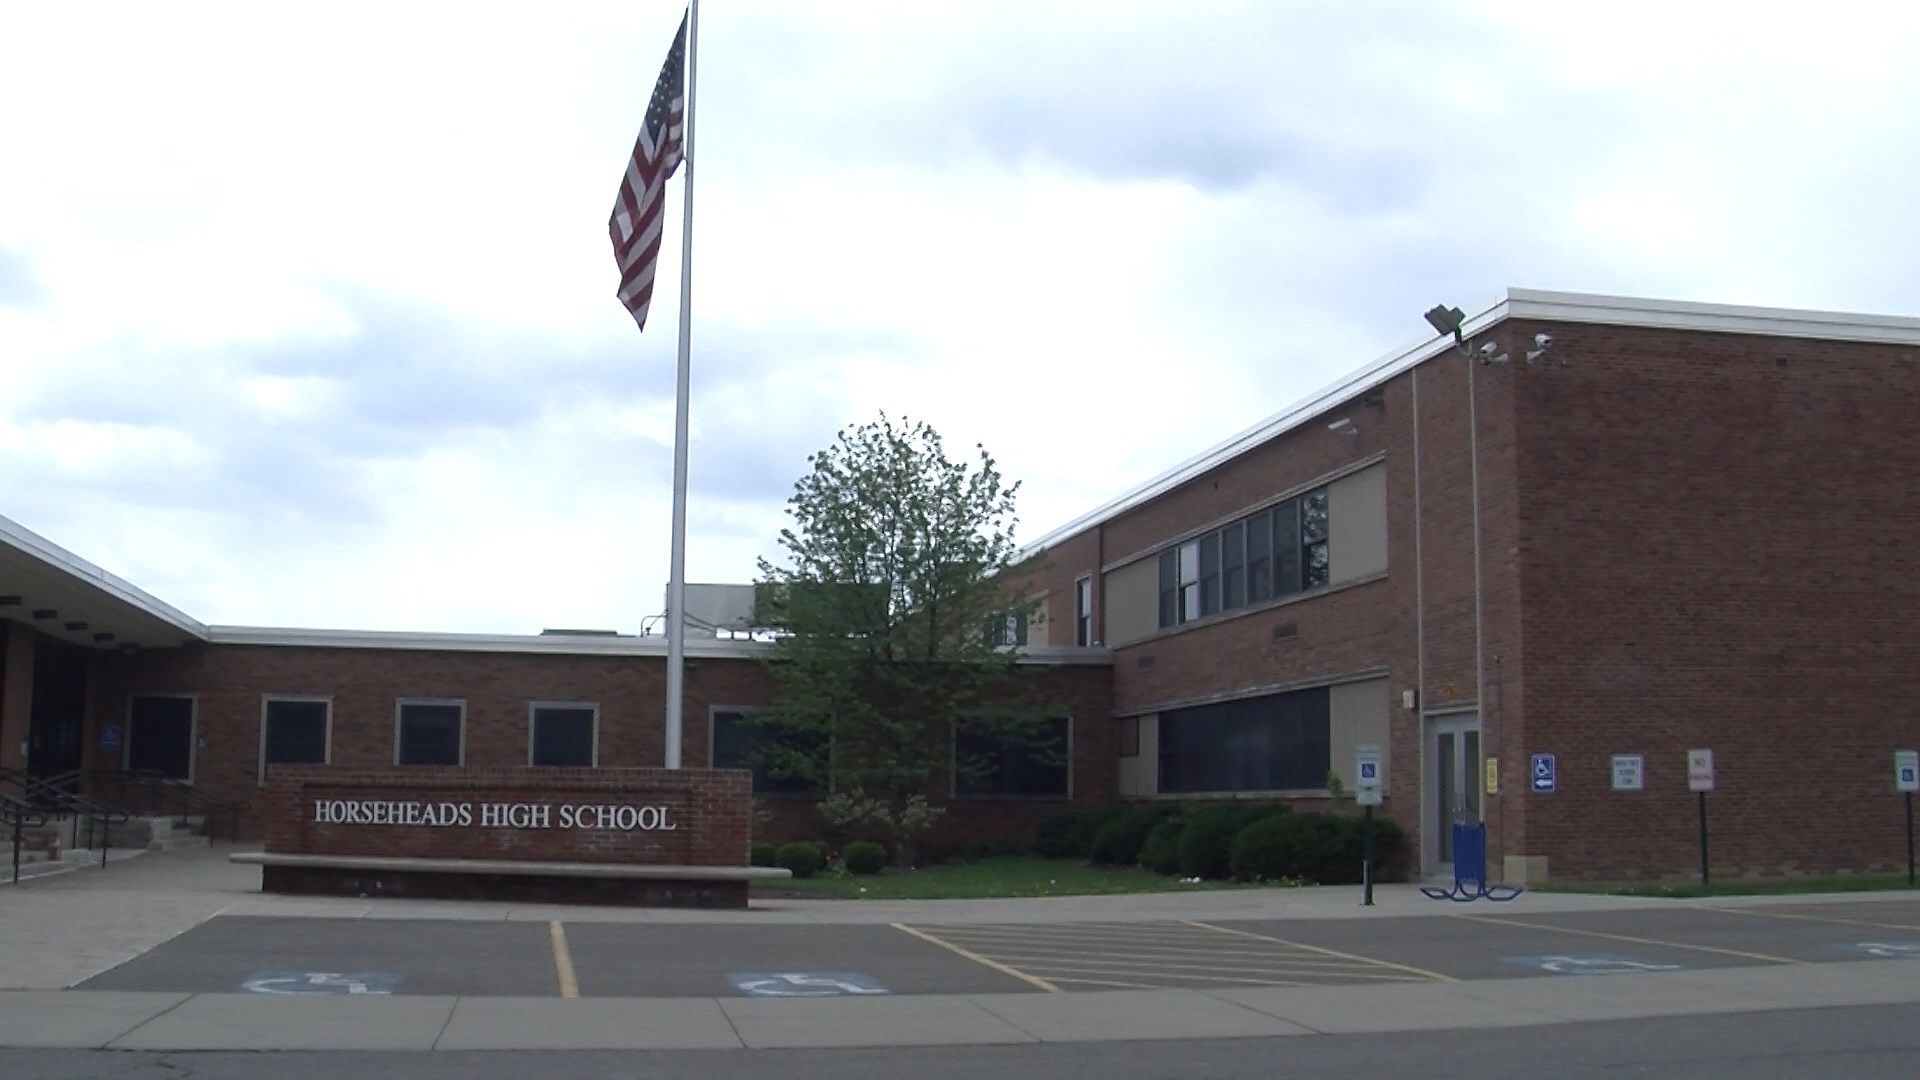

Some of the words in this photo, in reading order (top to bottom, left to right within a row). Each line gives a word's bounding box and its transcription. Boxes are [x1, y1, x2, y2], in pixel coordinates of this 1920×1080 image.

[315, 800, 472, 827] HORSEHEADS
[481, 804, 550, 829] HIGH
[558, 805, 677, 831] SCHOOL
